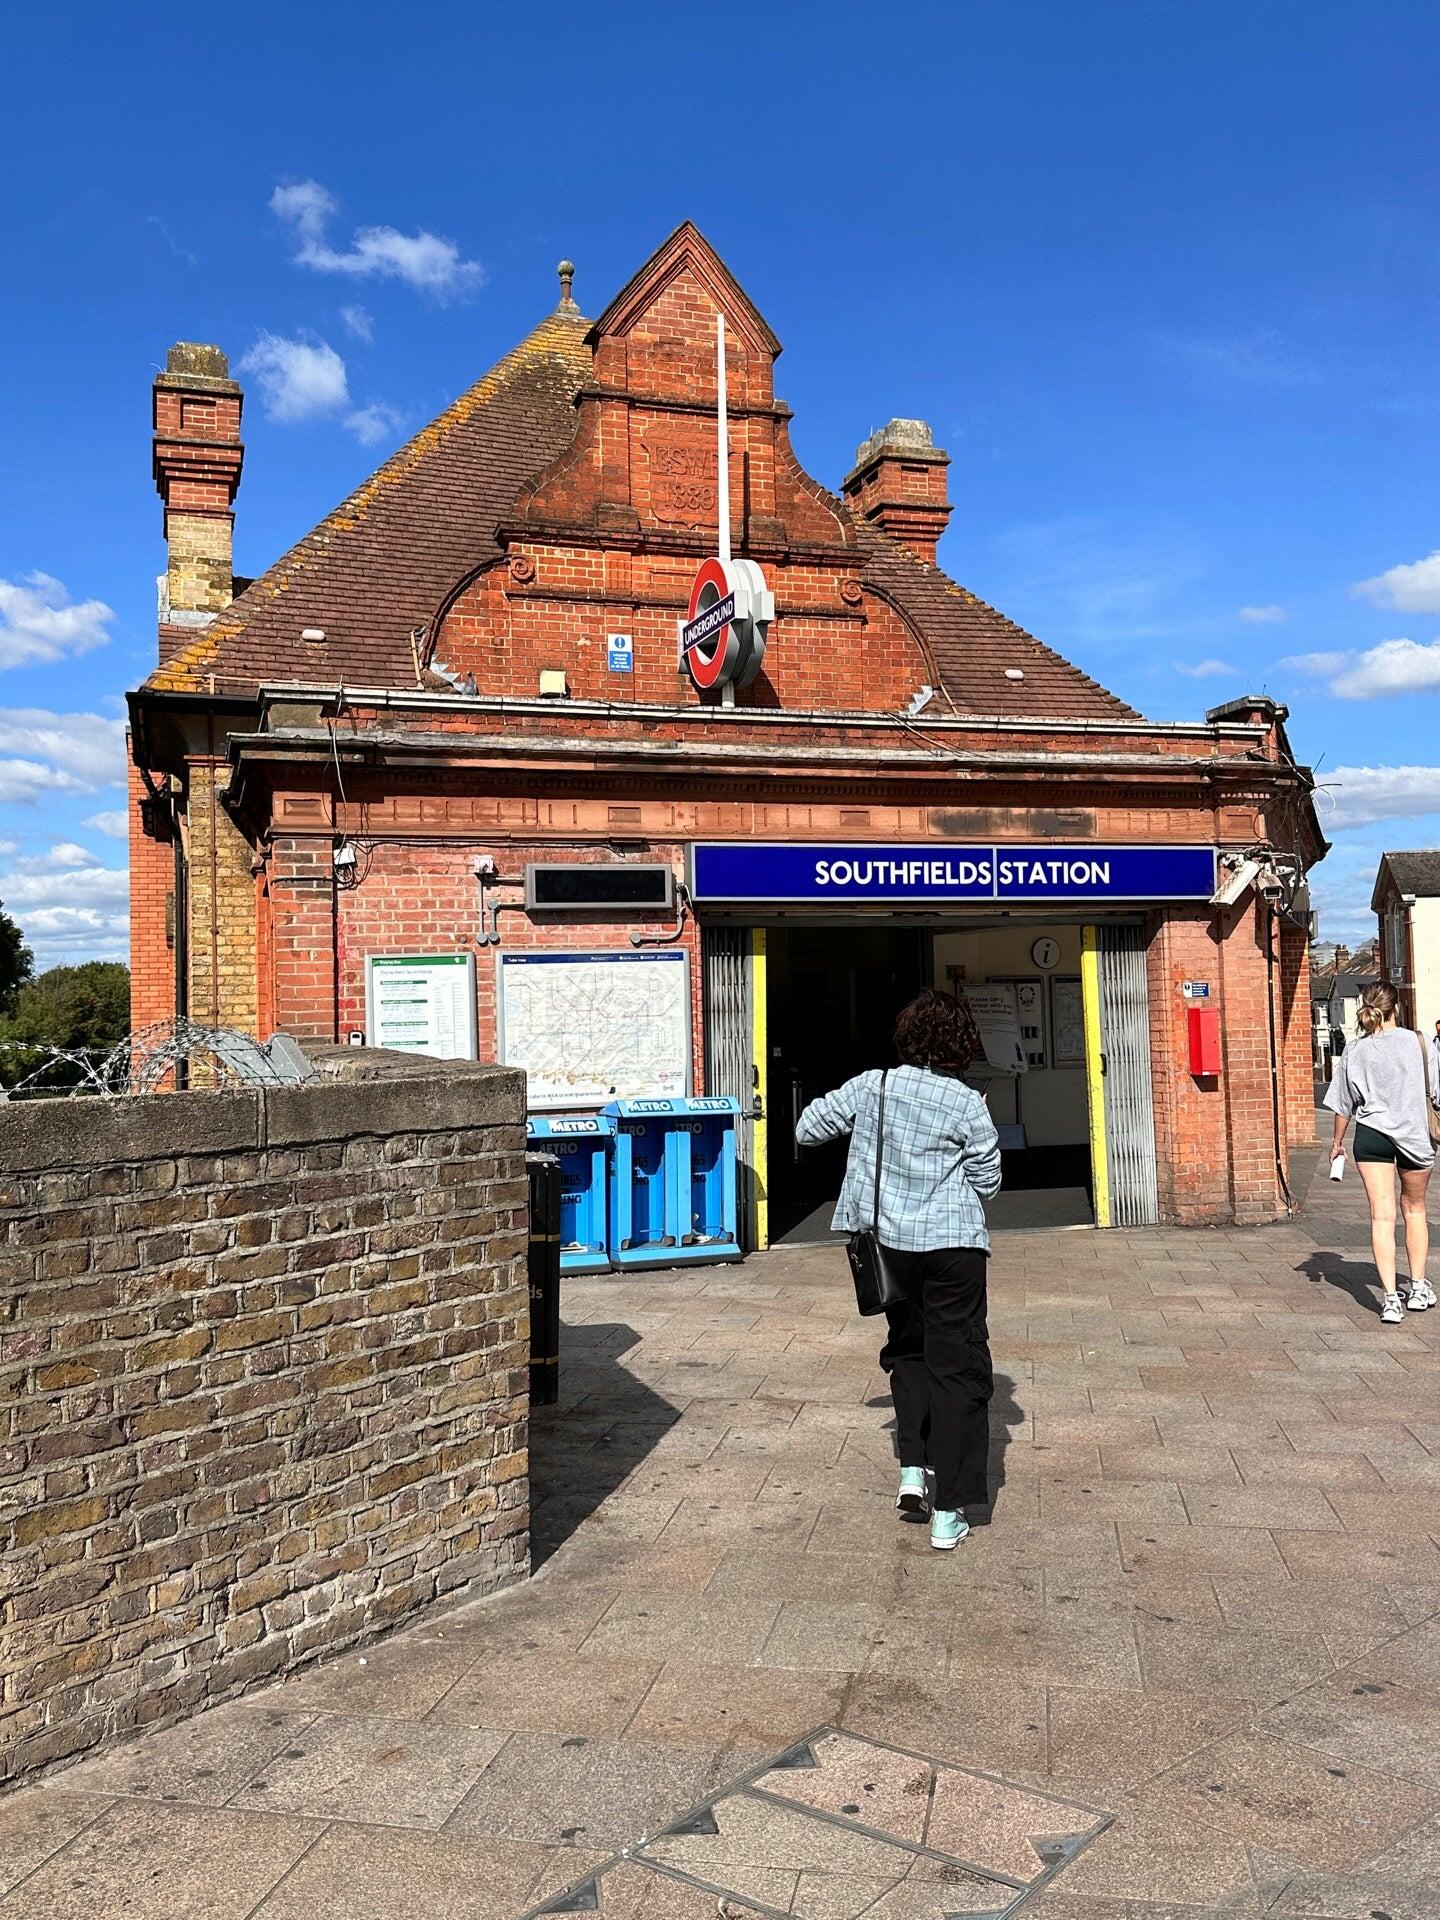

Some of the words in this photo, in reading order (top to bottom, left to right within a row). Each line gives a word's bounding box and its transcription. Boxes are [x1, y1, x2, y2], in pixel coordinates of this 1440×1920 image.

[684, 600, 733, 645] UNDERGROUND
[815, 860, 991, 885] SOUTHFIELDS
[999, 861, 1110, 885] STATION
[629, 1100, 671, 1112] METRO
[689, 1099, 729, 1111] METRO
[551, 1119, 598, 1132] METRO
